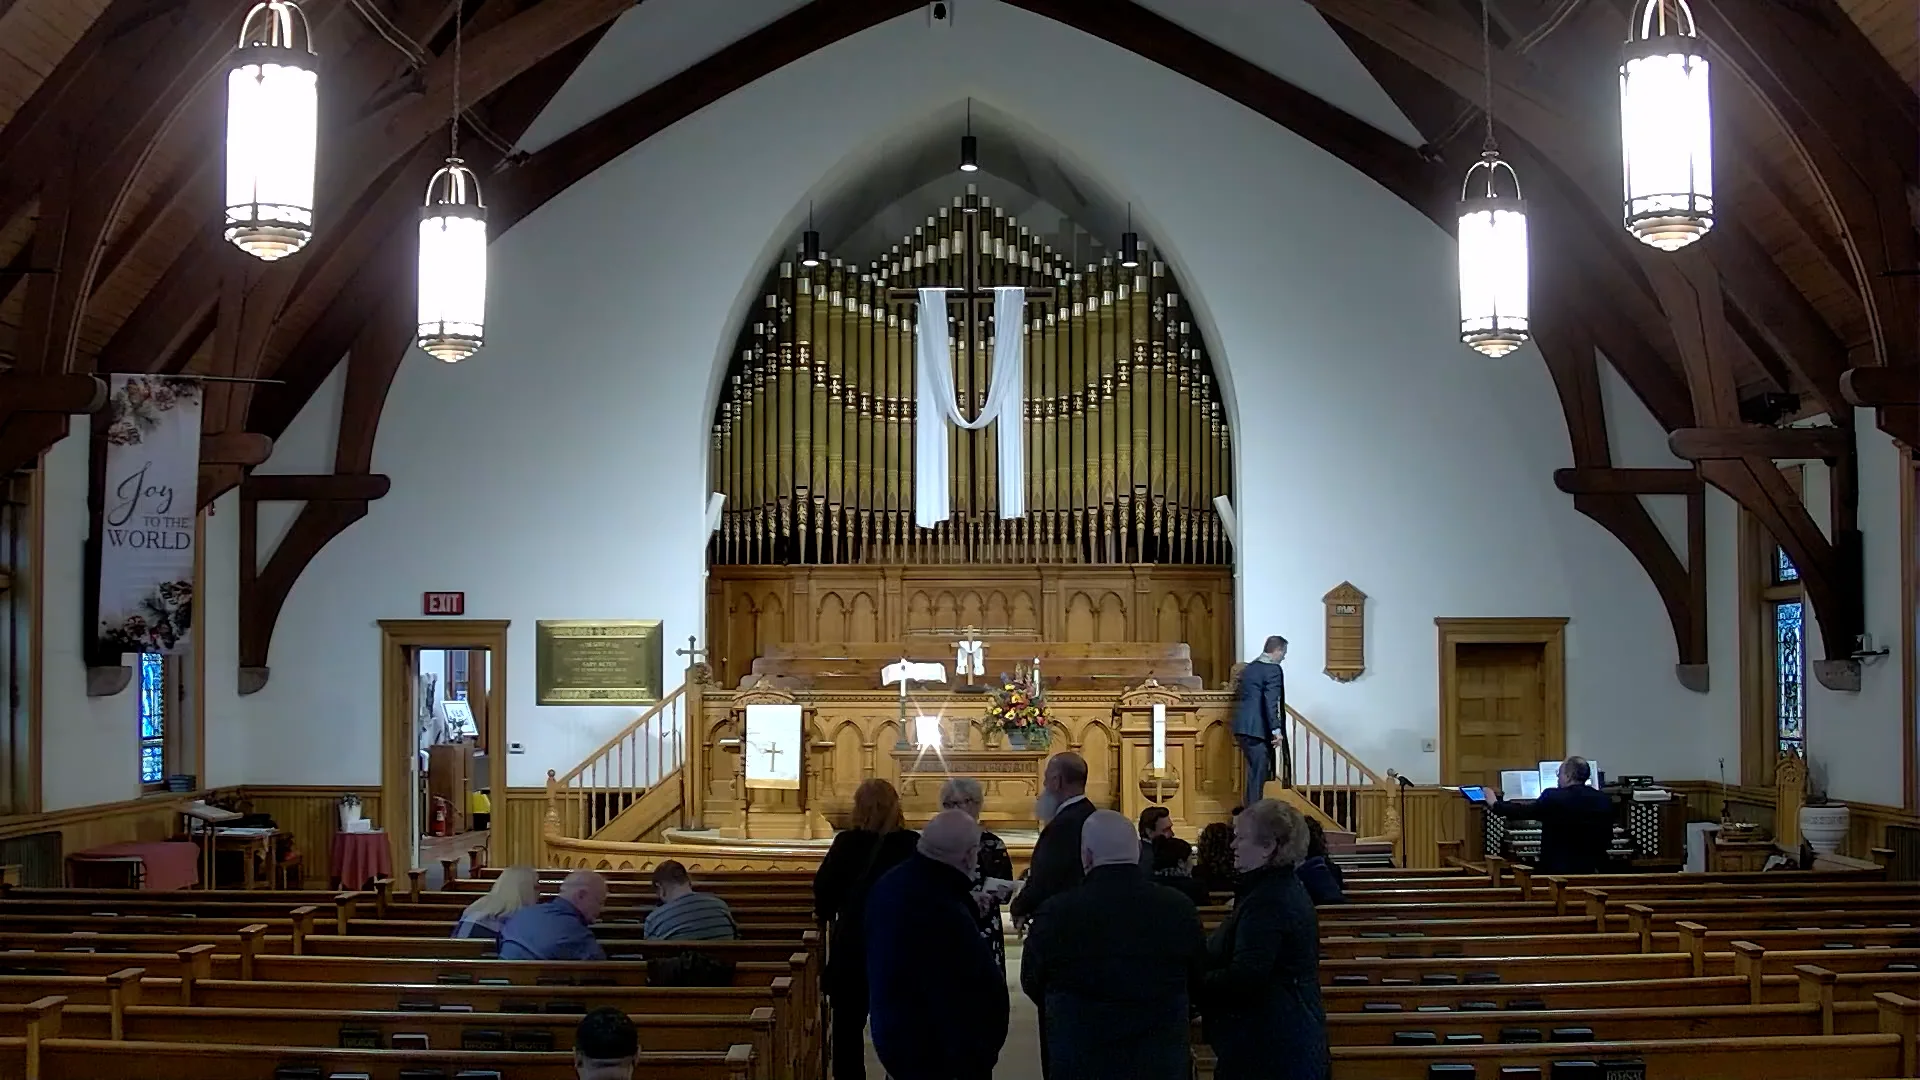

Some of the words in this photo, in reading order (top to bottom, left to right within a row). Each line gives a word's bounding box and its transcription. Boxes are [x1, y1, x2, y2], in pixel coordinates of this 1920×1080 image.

[107, 460, 173, 527] Joy
[143, 515, 161, 529] TO
[162, 516, 190, 529] THE
[106, 528, 191, 551] WORLD
[429, 593, 459, 612] EXIT
